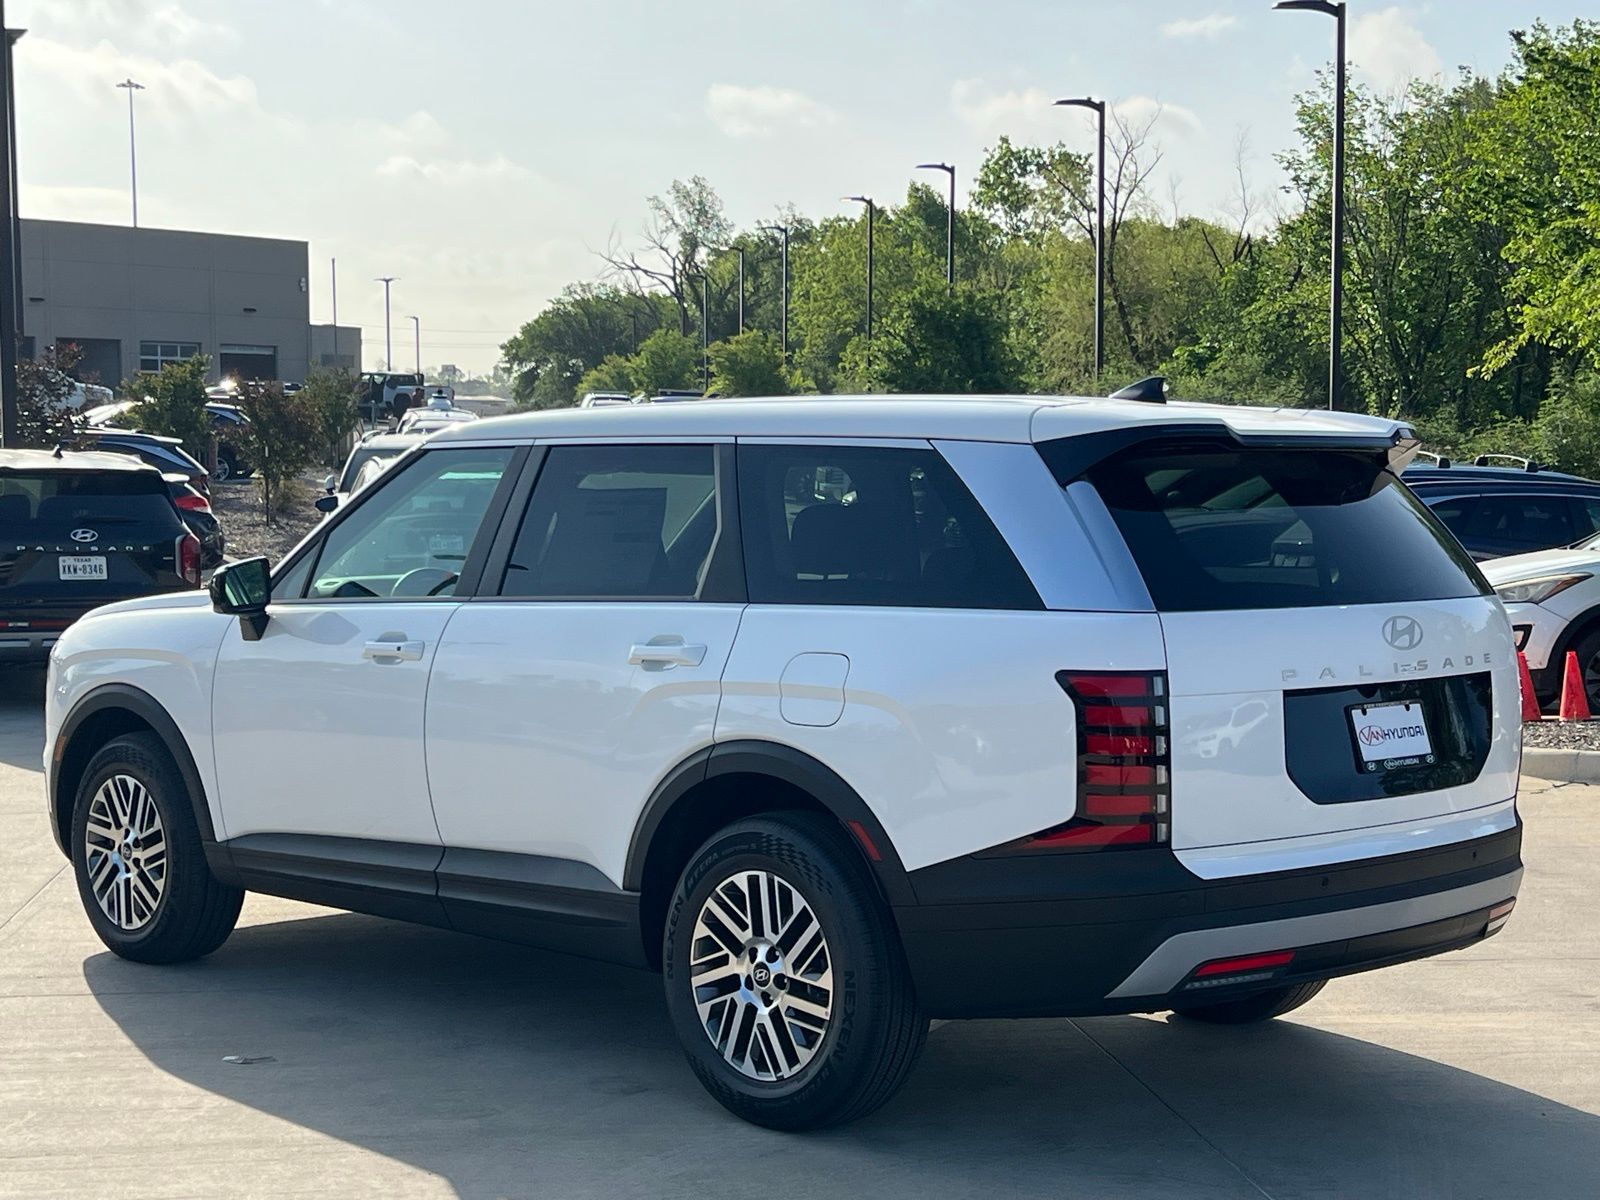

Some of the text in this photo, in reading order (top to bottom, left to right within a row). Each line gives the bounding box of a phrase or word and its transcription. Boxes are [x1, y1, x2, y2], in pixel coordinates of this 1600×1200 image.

[1281, 653, 1491, 681] PALISADE
[666, 894, 685, 980] NEXEN
[834, 970, 856, 1060] NEXEN
